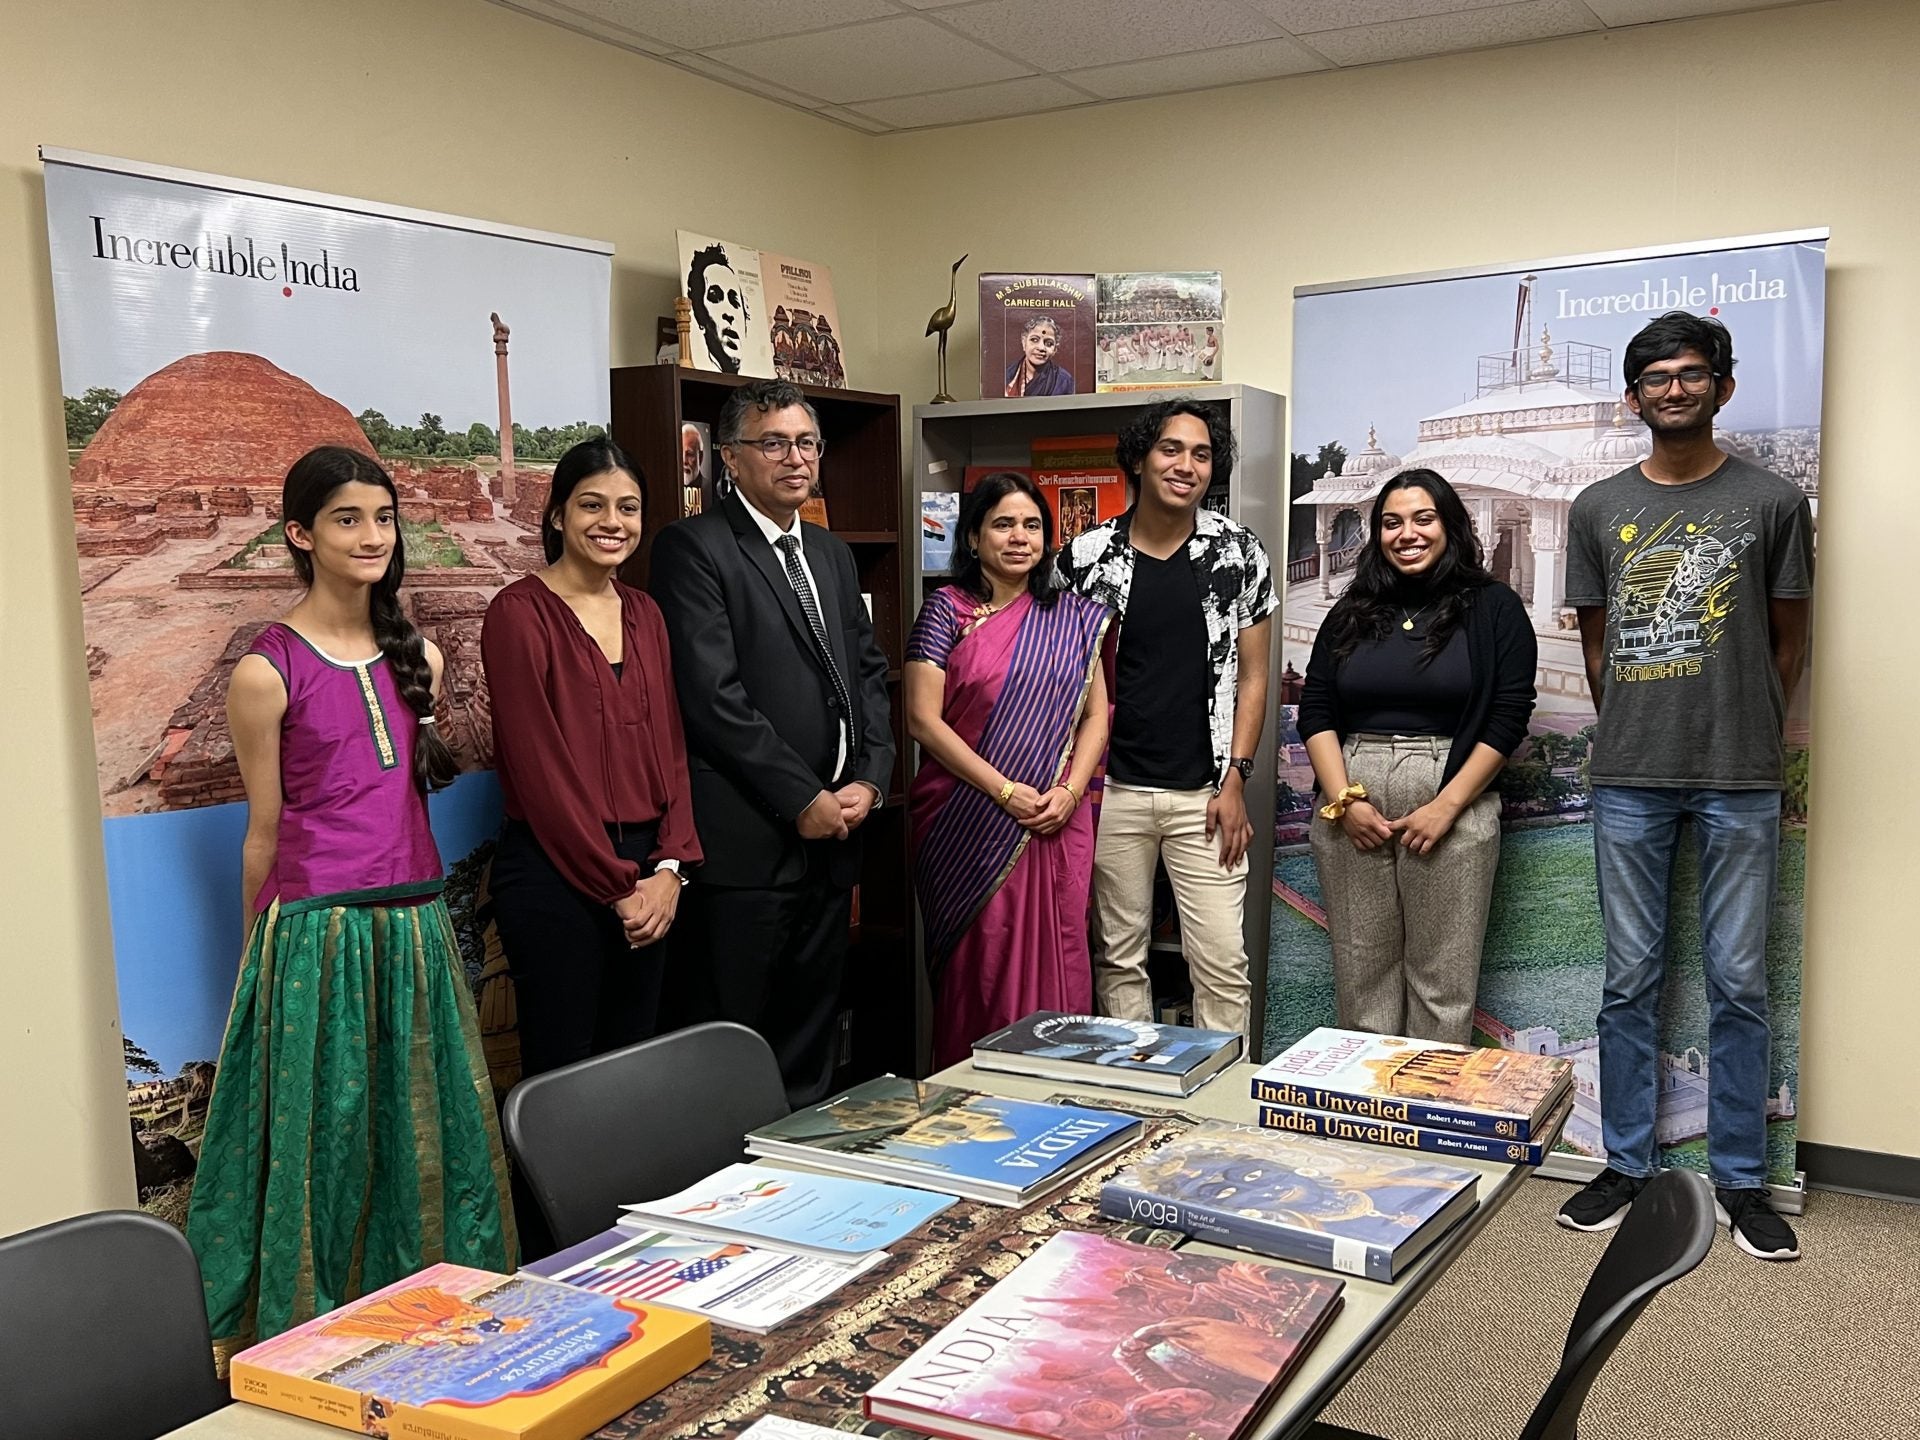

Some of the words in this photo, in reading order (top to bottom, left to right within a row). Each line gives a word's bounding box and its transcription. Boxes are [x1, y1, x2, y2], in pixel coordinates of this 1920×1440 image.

[89, 215, 277, 282] Incredible
[1004, 298, 1051, 308] CARNEGIE
[1052, 298, 1076, 308] HALL
[1556, 275, 1706, 319] Incredible
[1616, 657, 1703, 682] KNIGHTS
[1270, 1049, 1320, 1074] India
[1298, 1037, 1368, 1077] Unveiled
[1256, 1081, 1308, 1106] India
[1315, 1089, 1410, 1123] Unveiled
[1232, 1122, 1299, 1142] yoga
[1264, 1108, 1317, 1134] India
[1324, 1117, 1420, 1149] Unveiled
[1426, 1112, 1451, 1123] Robert
[1452, 1118, 1476, 1127] Arnett
[1001, 1118, 1111, 1168] INDIA
[1437, 1138, 1462, 1148] Robert
[1463, 1142, 1488, 1152] Arnett
[1128, 1196, 1178, 1225] yoga
[1187, 1211, 1199, 1220] The
[1199, 1214, 1208, 1222] Art
[1187, 1218, 1230, 1234] Transformation
[499, 1328, 602, 1384] Miniatures
[892, 1309, 1034, 1401] INDIA
[243, 1377, 268, 1389] BOOKS
